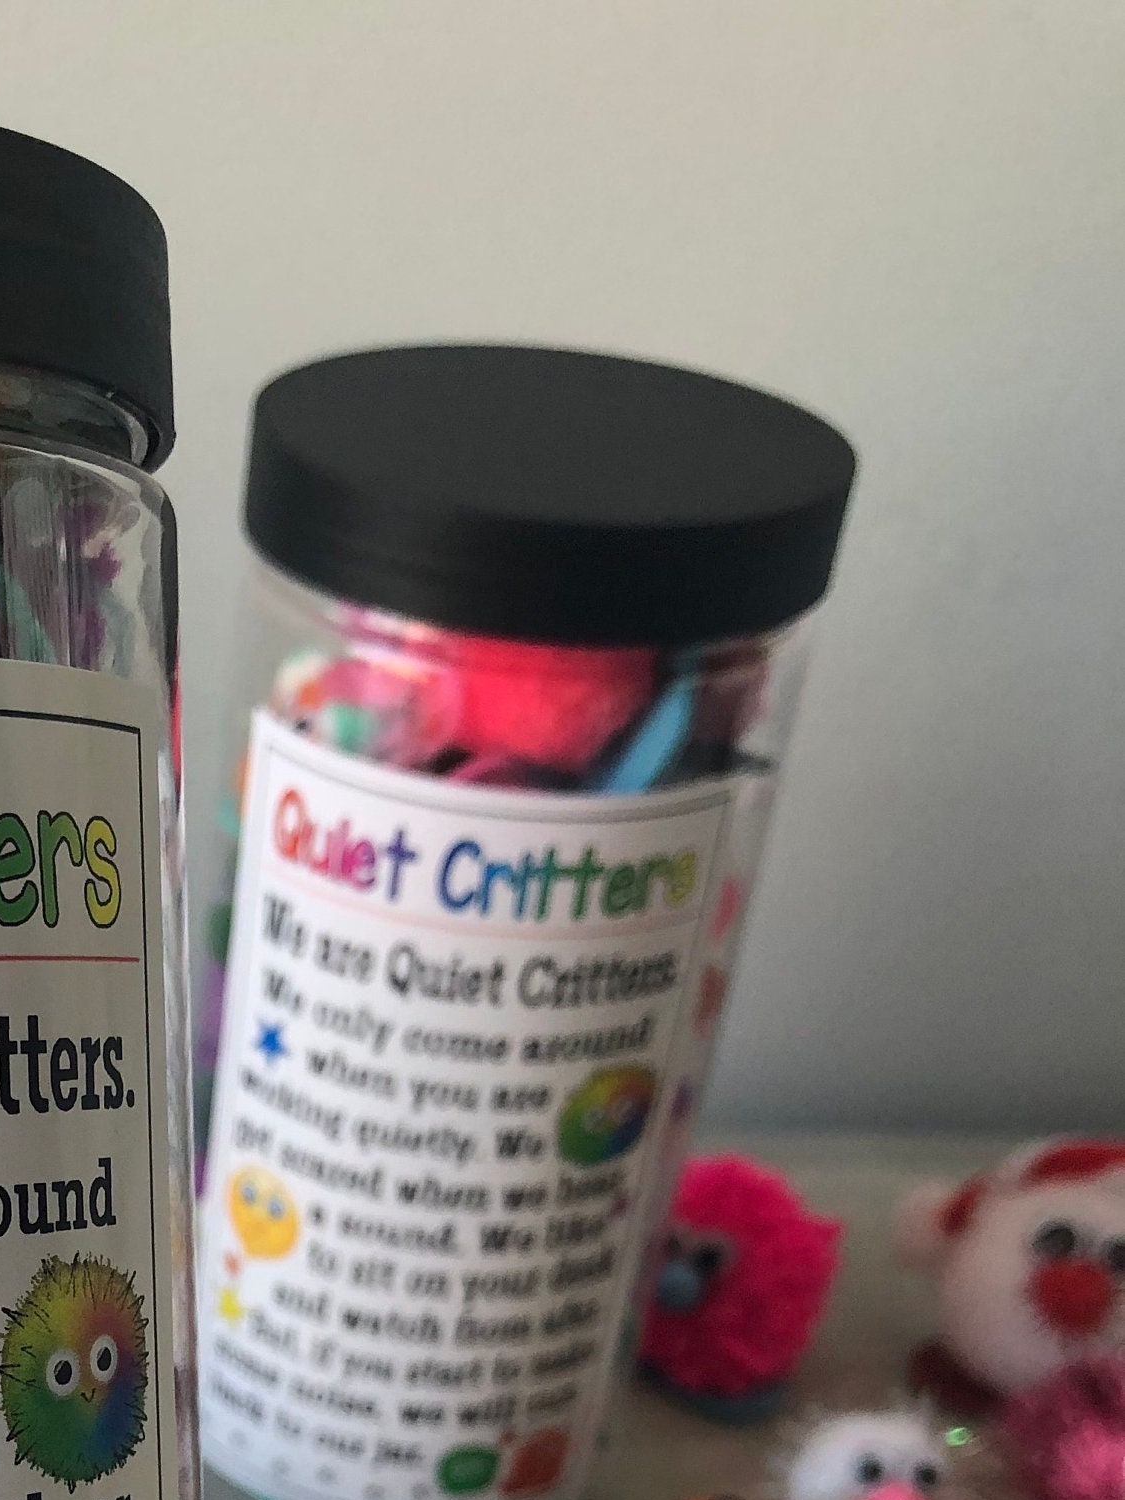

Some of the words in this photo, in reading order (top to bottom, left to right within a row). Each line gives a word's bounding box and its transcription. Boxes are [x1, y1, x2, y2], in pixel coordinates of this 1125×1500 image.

[274, 787, 417, 901] Quiet
[439, 838, 696, 922] Critters
[262, 895, 304, 958] We
[314, 931, 374, 984] are
[386, 944, 505, 1007] Quiet
[517, 952, 677, 1007] Critters.
